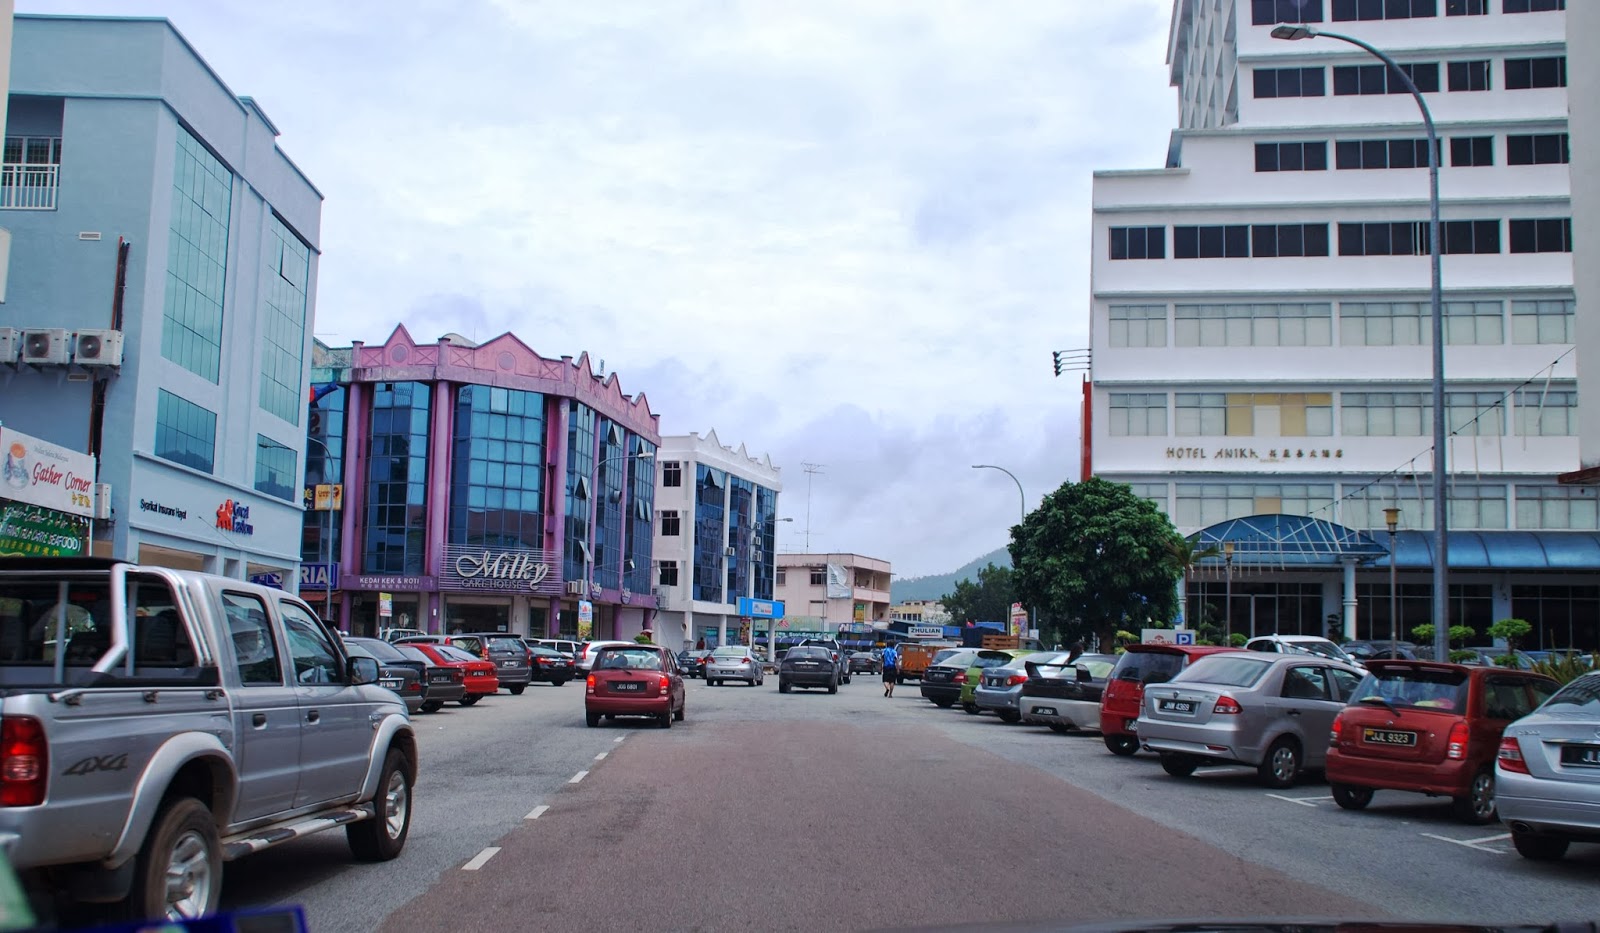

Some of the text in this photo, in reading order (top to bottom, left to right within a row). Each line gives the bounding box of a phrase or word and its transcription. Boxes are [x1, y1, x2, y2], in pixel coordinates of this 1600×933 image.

[1166, 447, 1259, 459] HOTEL ANIKA
[32, 462, 92, 492] Gather Corner
[140, 499, 187, 520] Syarikat Insurans Hayat
[455, 550, 549, 590] Milky
[461, 580, 523, 589] CAKE HOUSE
[1178, 634, 1190, 645] P
[1371, 732, 1409, 743] JJL 9323
